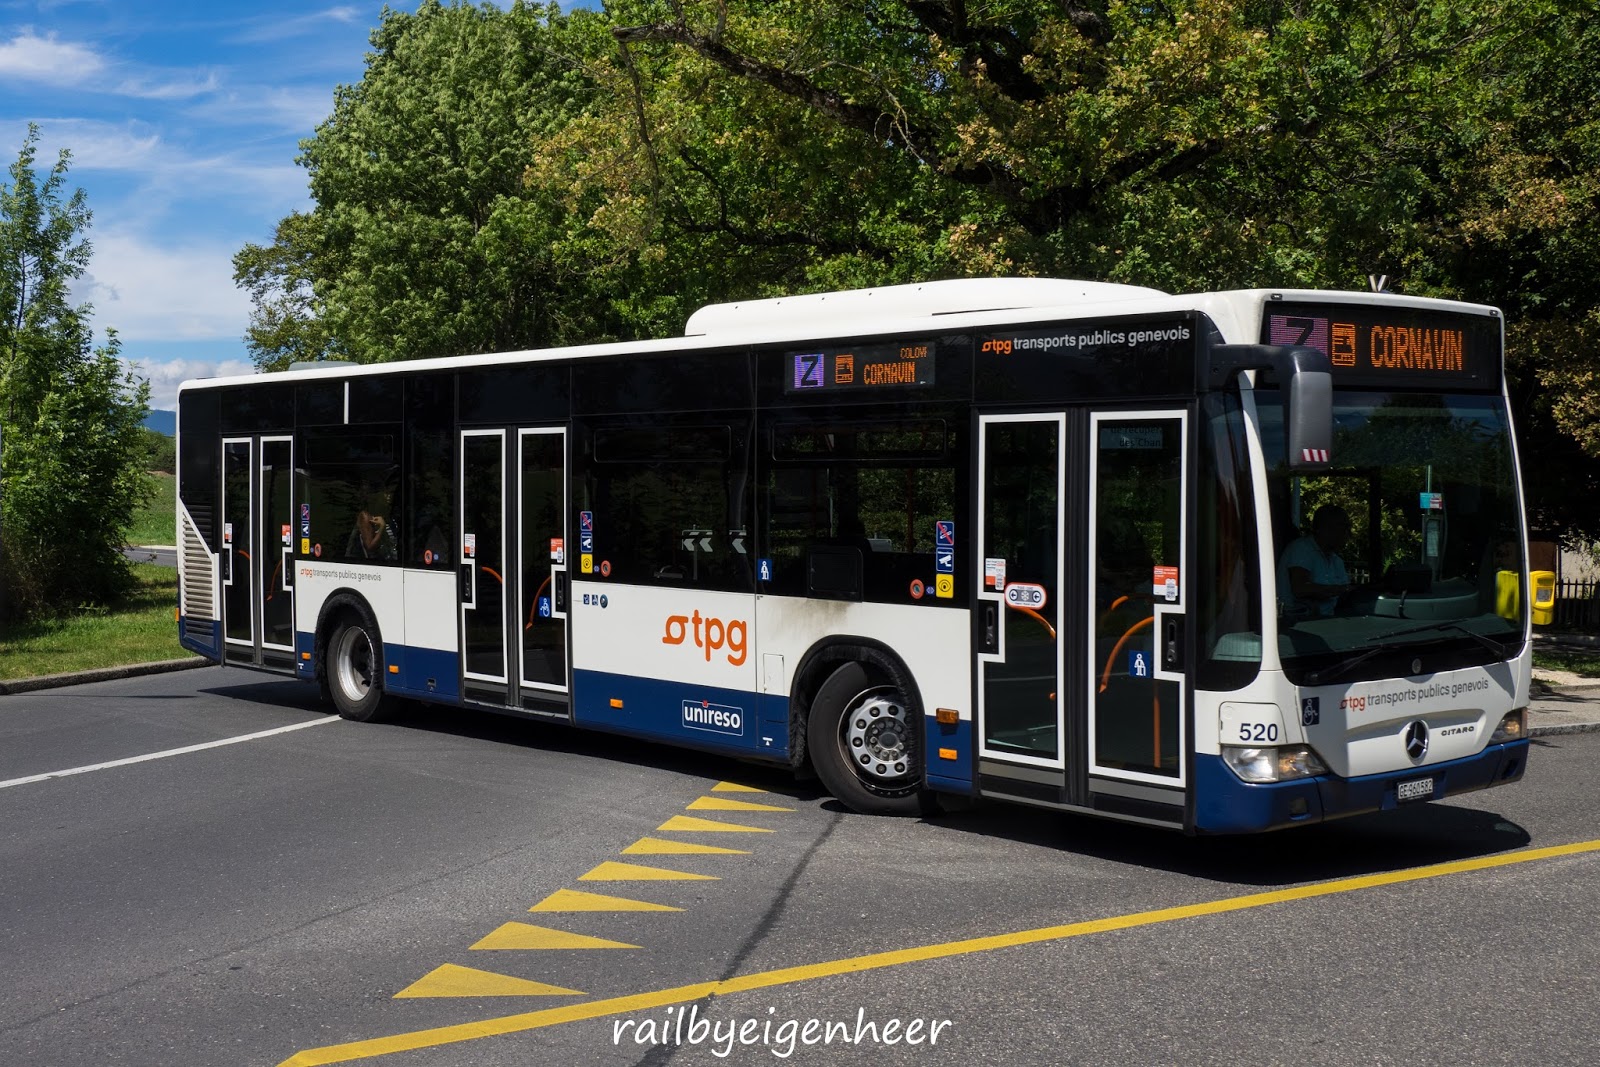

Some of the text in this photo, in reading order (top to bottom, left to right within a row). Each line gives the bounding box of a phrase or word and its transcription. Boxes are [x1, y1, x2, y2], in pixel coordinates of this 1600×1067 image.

[993, 326, 1190, 354] tpg transports publics genevois
[1370, 325, 1463, 370] CORNAVIN
[800, 355, 819, 386] Z
[863, 361, 916, 385] CORNAVIN
[313, 569, 338, 579] transports
[338, 569, 357, 580] publics
[358, 572, 382, 582] genevois
[692, 609, 747, 666] tpg
[1349, 678, 1489, 711] tpg transports publics genevois
[684, 702, 741, 729] unireso
[1239, 723, 1278, 741] 520
[1441, 726, 1475, 736] CITARO
